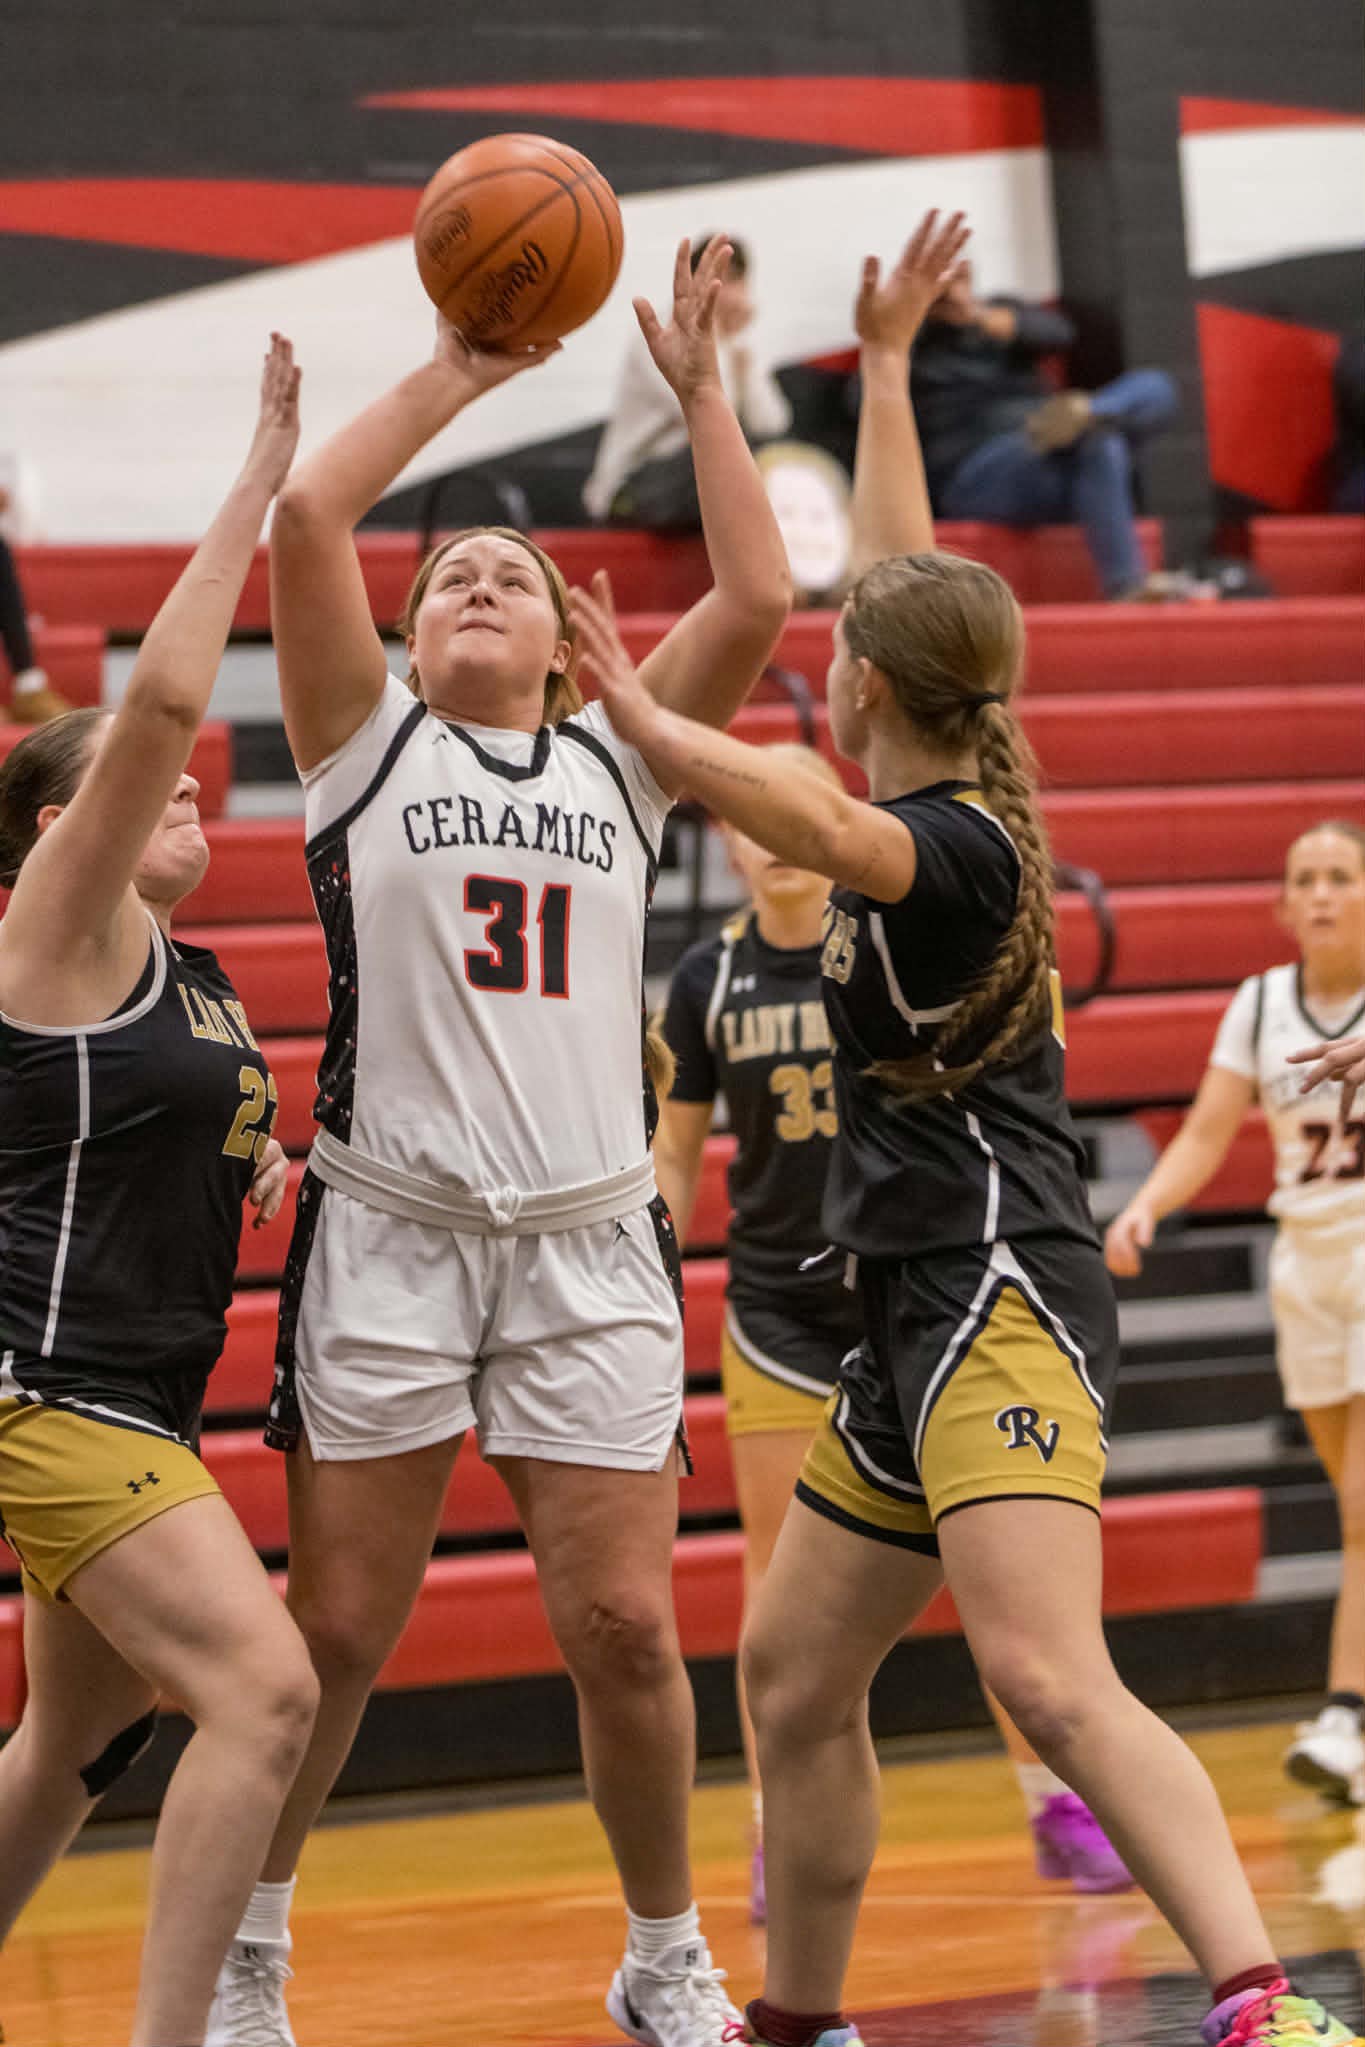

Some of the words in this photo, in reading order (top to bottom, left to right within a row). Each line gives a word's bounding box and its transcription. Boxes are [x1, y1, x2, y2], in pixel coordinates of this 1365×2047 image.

[402, 794, 617, 873] CERAMICS
[463, 873, 572, 1000] 31
[994, 1404, 1060, 1464] RV
